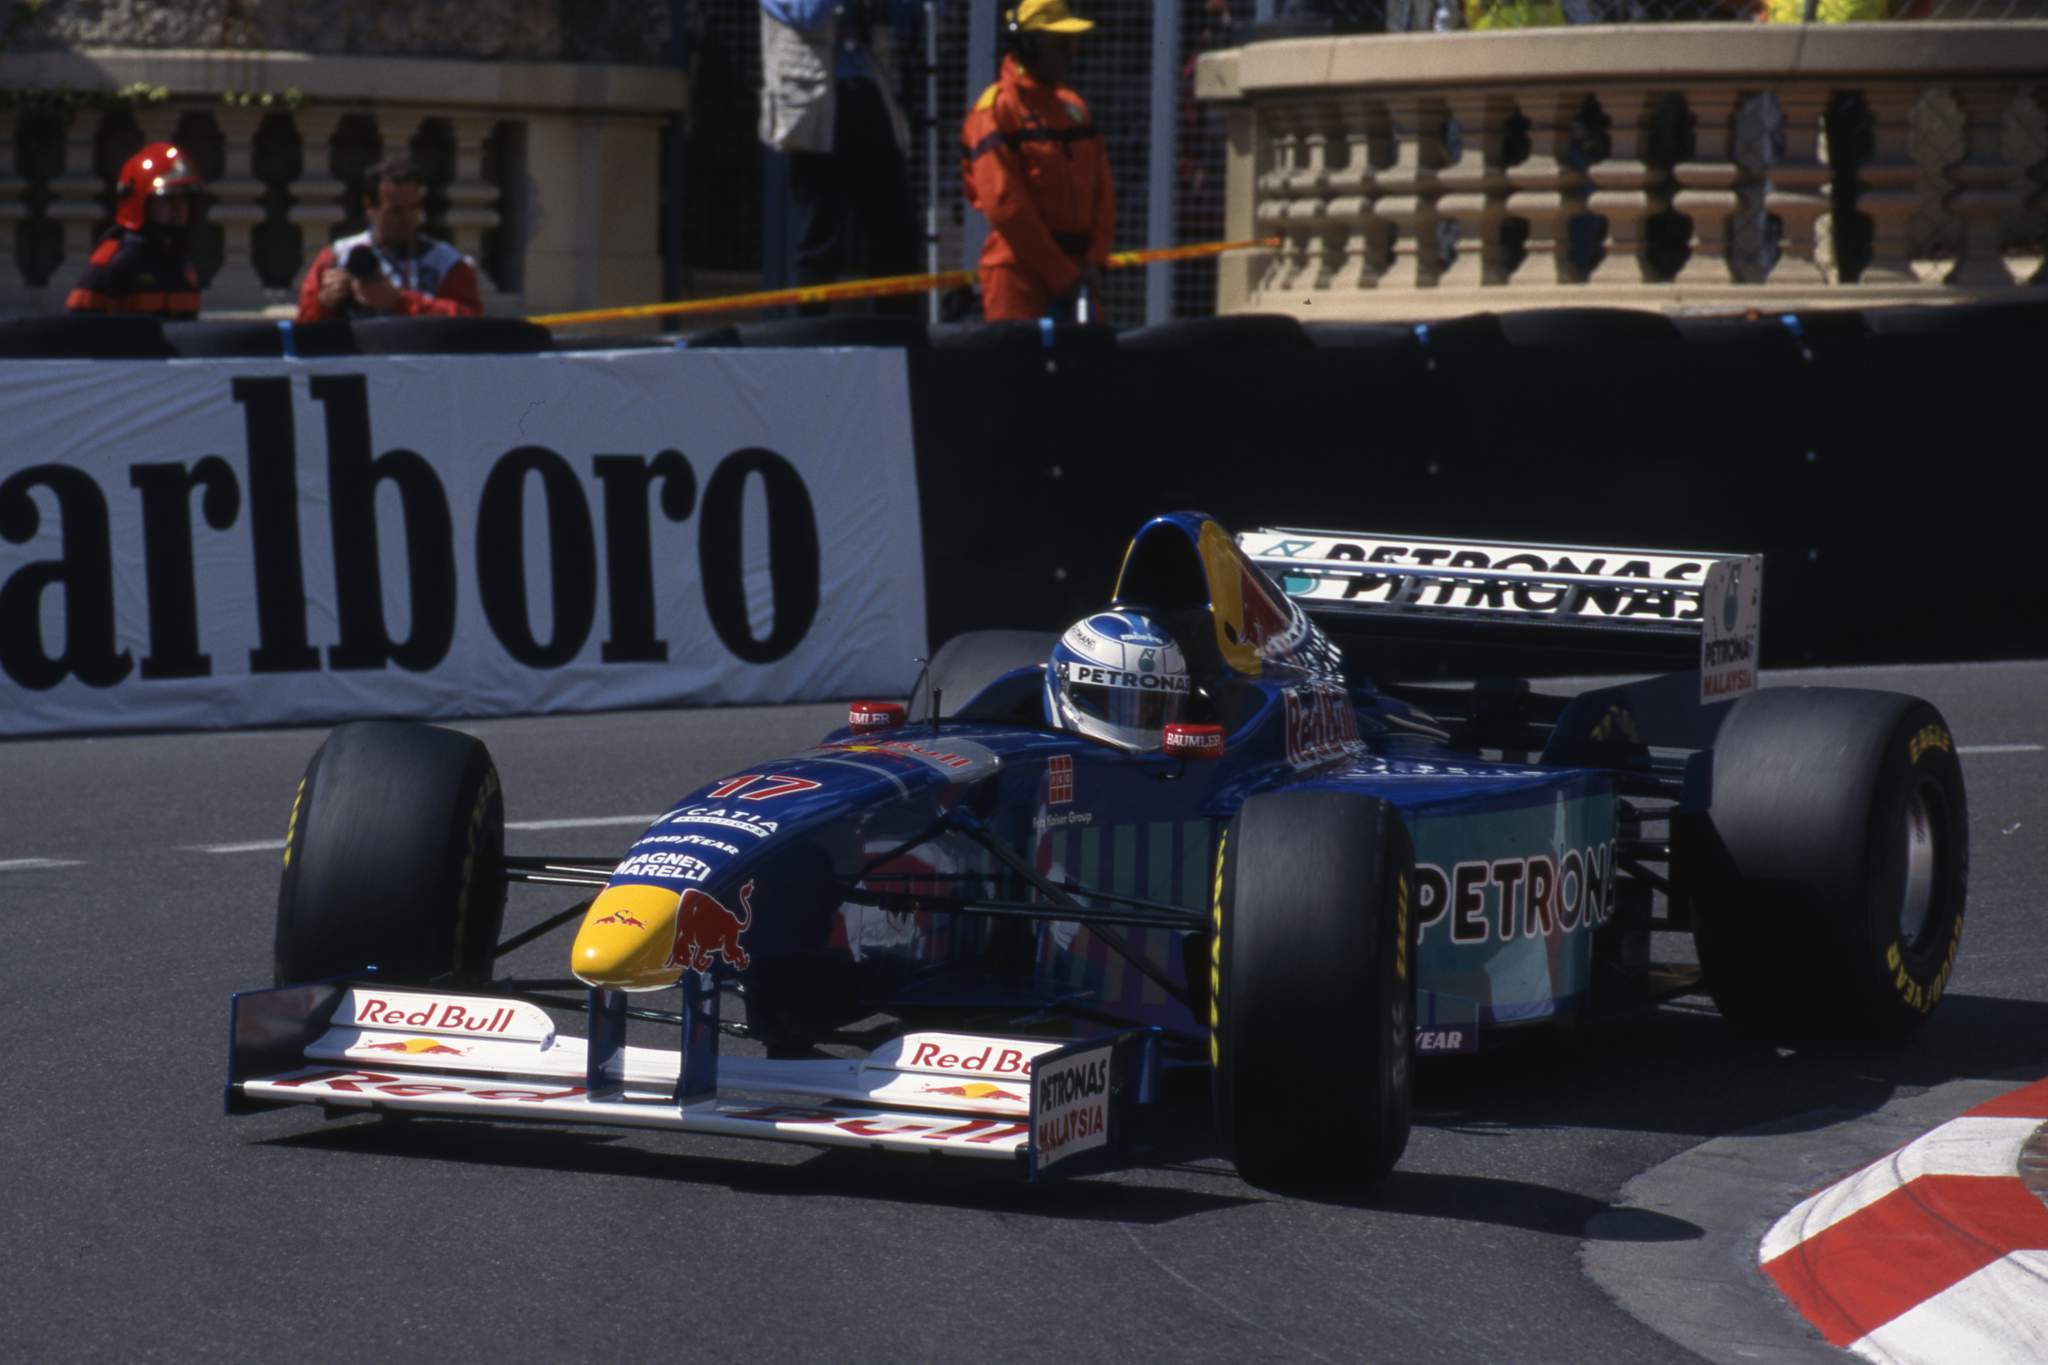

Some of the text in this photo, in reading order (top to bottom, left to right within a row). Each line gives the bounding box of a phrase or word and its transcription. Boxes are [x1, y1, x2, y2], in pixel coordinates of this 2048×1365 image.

[707, 775, 823, 801] 17
[687, 807, 779, 833] CATIA
[355, 999, 515, 1034] Red Bull
[910, 1042, 992, 1071] Red
[1039, 1058, 1107, 1115] PETRONAS
[1038, 1103, 1104, 1152] MALAYSIA
